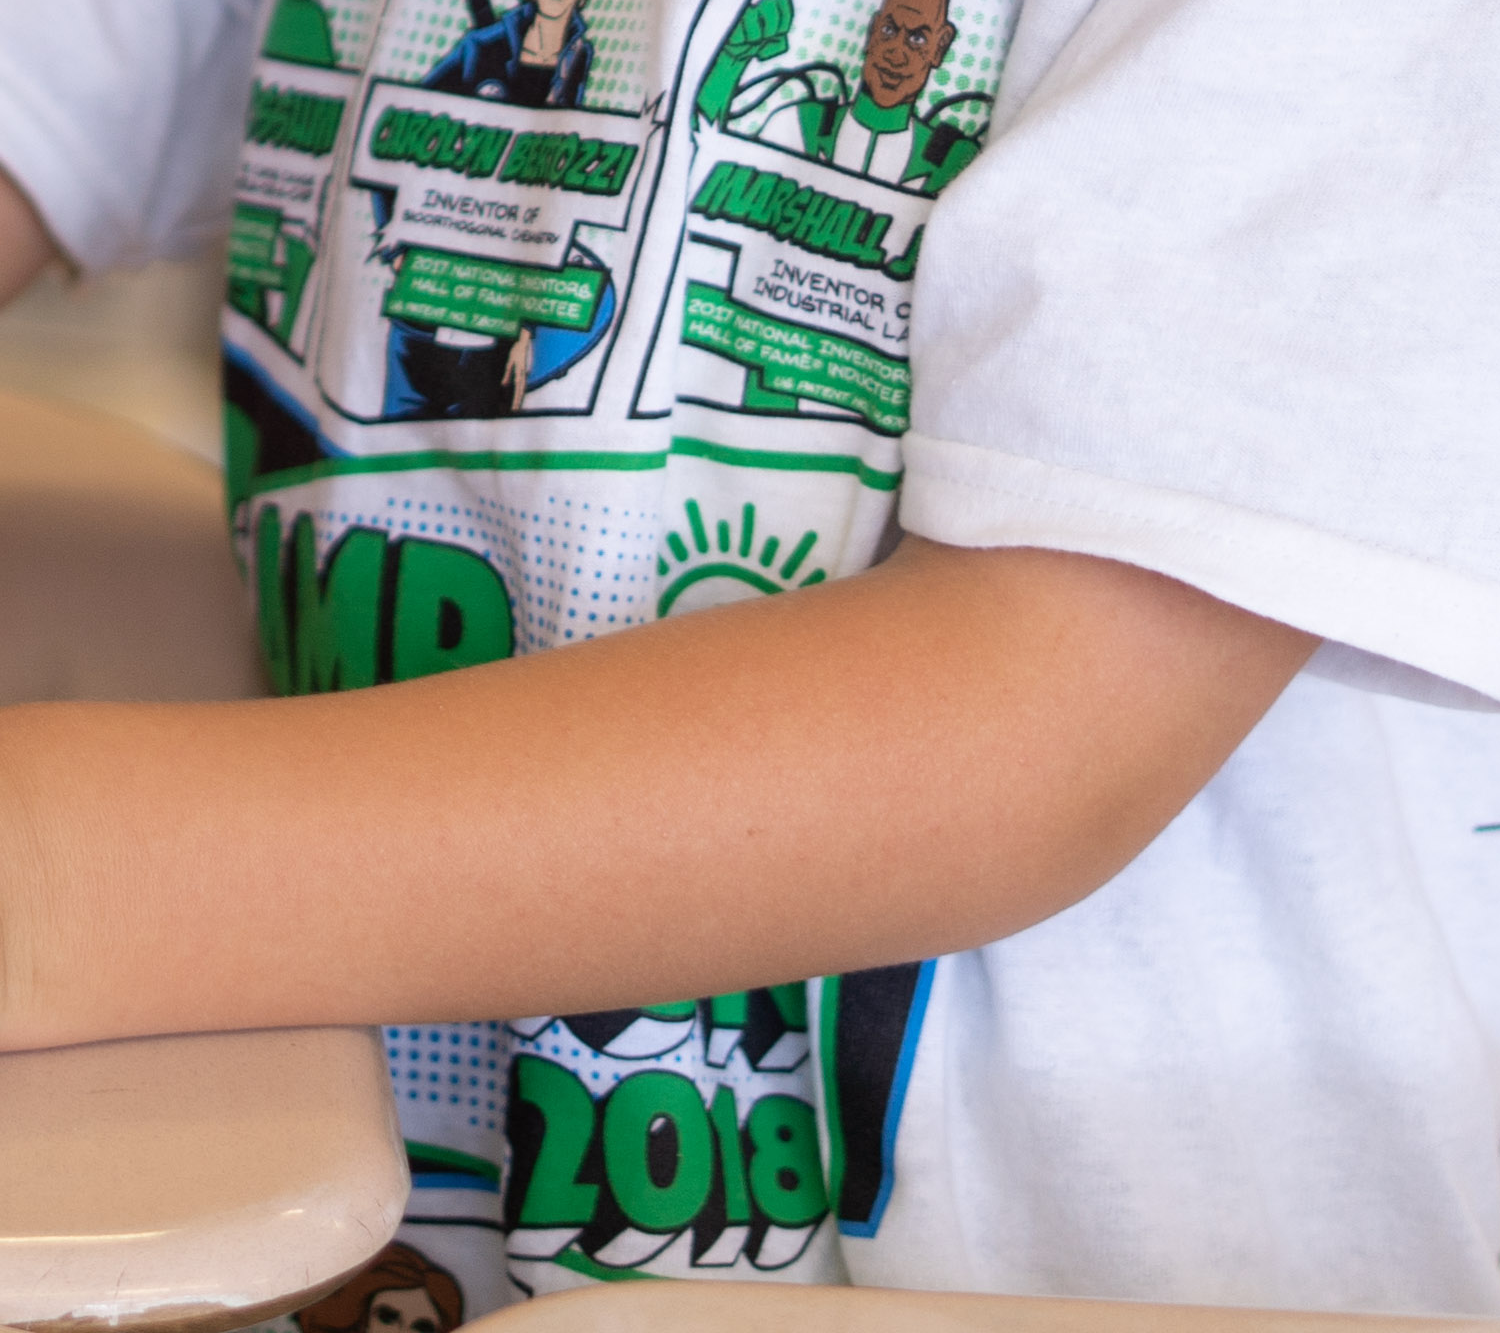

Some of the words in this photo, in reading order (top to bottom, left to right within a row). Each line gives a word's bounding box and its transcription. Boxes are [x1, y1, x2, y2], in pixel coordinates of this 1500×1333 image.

[369, 104, 514, 179] CAROLYN
[422, 189, 519, 222] INVENTOR
[523, 206, 541, 224] OF
[688, 160, 893, 271] MARSHALL
[411, 277, 449, 296] HALL
[453, 285, 476, 299] OF
[753, 276, 875, 331] INDUSTRIAL
[772, 259, 885, 313] INVENTOR
[895, 301, 912, 320] O
[688, 298, 734, 323] 2017
[734, 315, 813, 350] NATIONAL
[688, 321, 730, 345] HALL
[734, 337, 756, 354] OF
[828, 361, 907, 405] INDUCTEE
[510, 1052, 832, 1234] 2018
